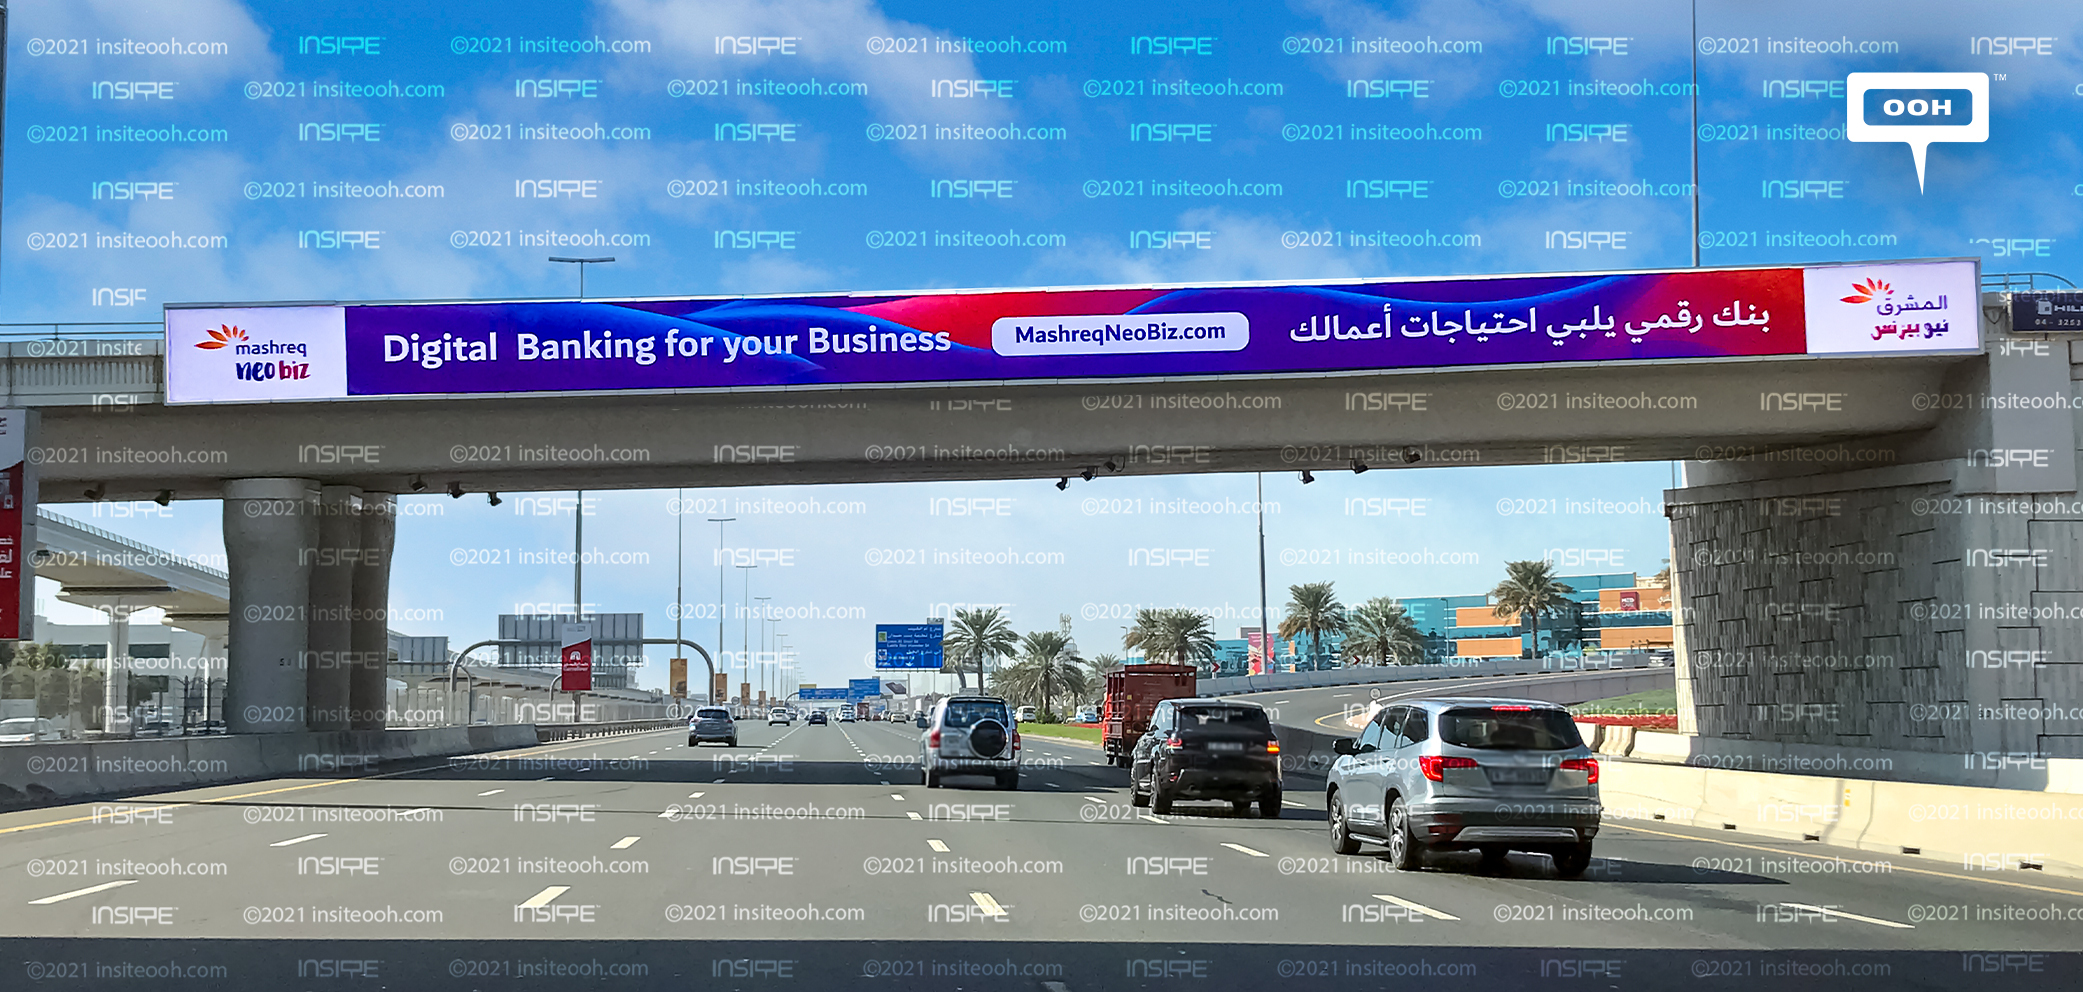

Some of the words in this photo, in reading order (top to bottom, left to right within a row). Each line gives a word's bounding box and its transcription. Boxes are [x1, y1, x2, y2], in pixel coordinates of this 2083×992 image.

[1624, 300, 1703, 343] رقمي
[1712, 300, 1770, 332] بنك
[1877, 295, 1948, 316] المشرق
[1015, 322, 1226, 346] MashreqNeoBiz.com
[1290, 303, 1392, 342] أعمالك
[1401, 308, 1536, 343] احتياجات
[1546, 305, 1616, 346] يلبي
[1923, 319, 1949, 339] نيو
[236, 340, 306, 357] mashreq
[384, 332, 497, 369] Digital
[517, 330, 656, 365] Banking
[665, 328, 713, 357] for
[723, 334, 798, 363] your
[809, 325, 951, 354] Business
